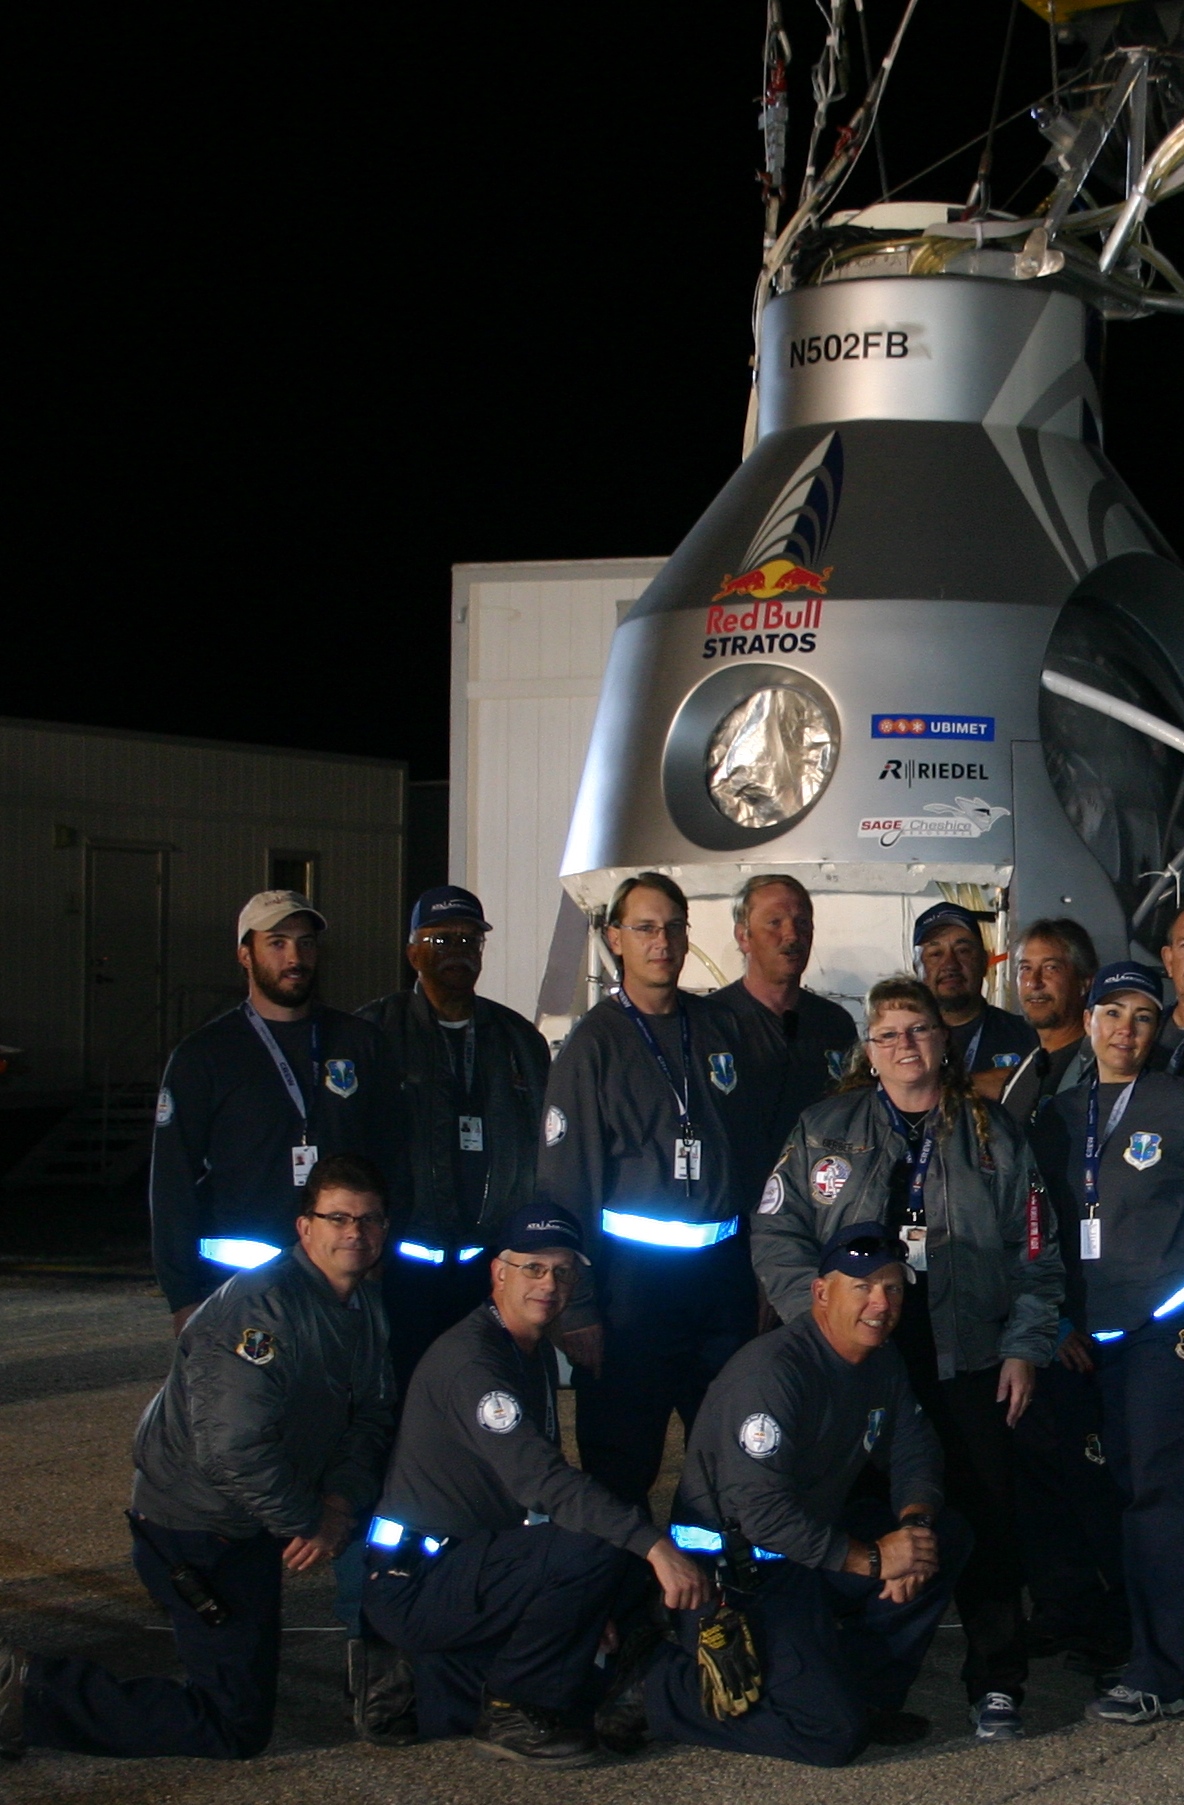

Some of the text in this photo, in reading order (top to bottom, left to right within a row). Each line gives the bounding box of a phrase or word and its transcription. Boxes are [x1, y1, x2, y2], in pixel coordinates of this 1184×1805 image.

[790, 331, 909, 369] N502FB
[706, 598, 823, 635] Red Bull
[702, 632, 817, 660] STRATOS
[930, 721, 988, 735] UBIMET
[918, 763, 989, 780] RIEDEL
[861, 819, 972, 831] SAGE Cheshire
[919, 1138, 933, 1164] CREW
